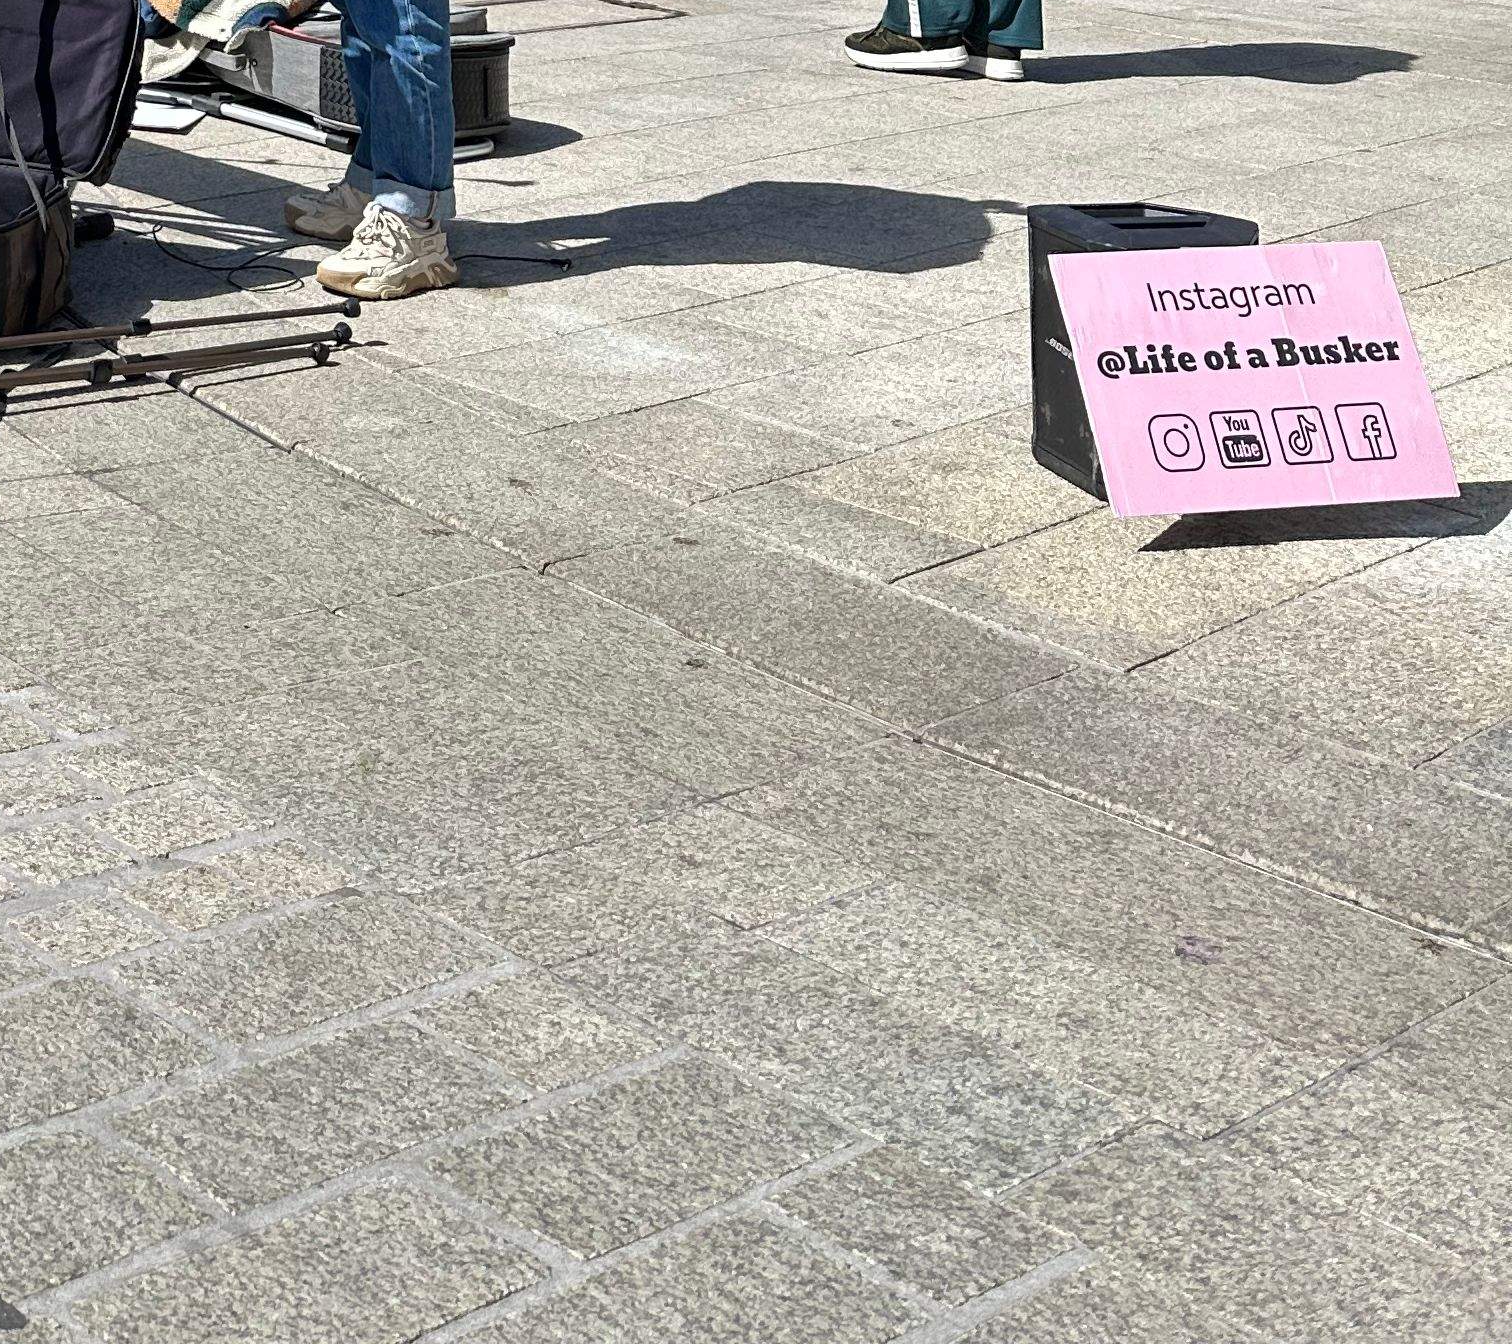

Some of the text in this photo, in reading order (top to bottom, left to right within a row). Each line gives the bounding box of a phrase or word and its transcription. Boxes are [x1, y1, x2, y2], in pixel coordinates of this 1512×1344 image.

[1146, 282, 1316, 318] Instagram
[1096, 335, 1400, 379] @Life of a Busker
[1222, 415, 1251, 432] You
[1224, 438, 1261, 460] Tube
